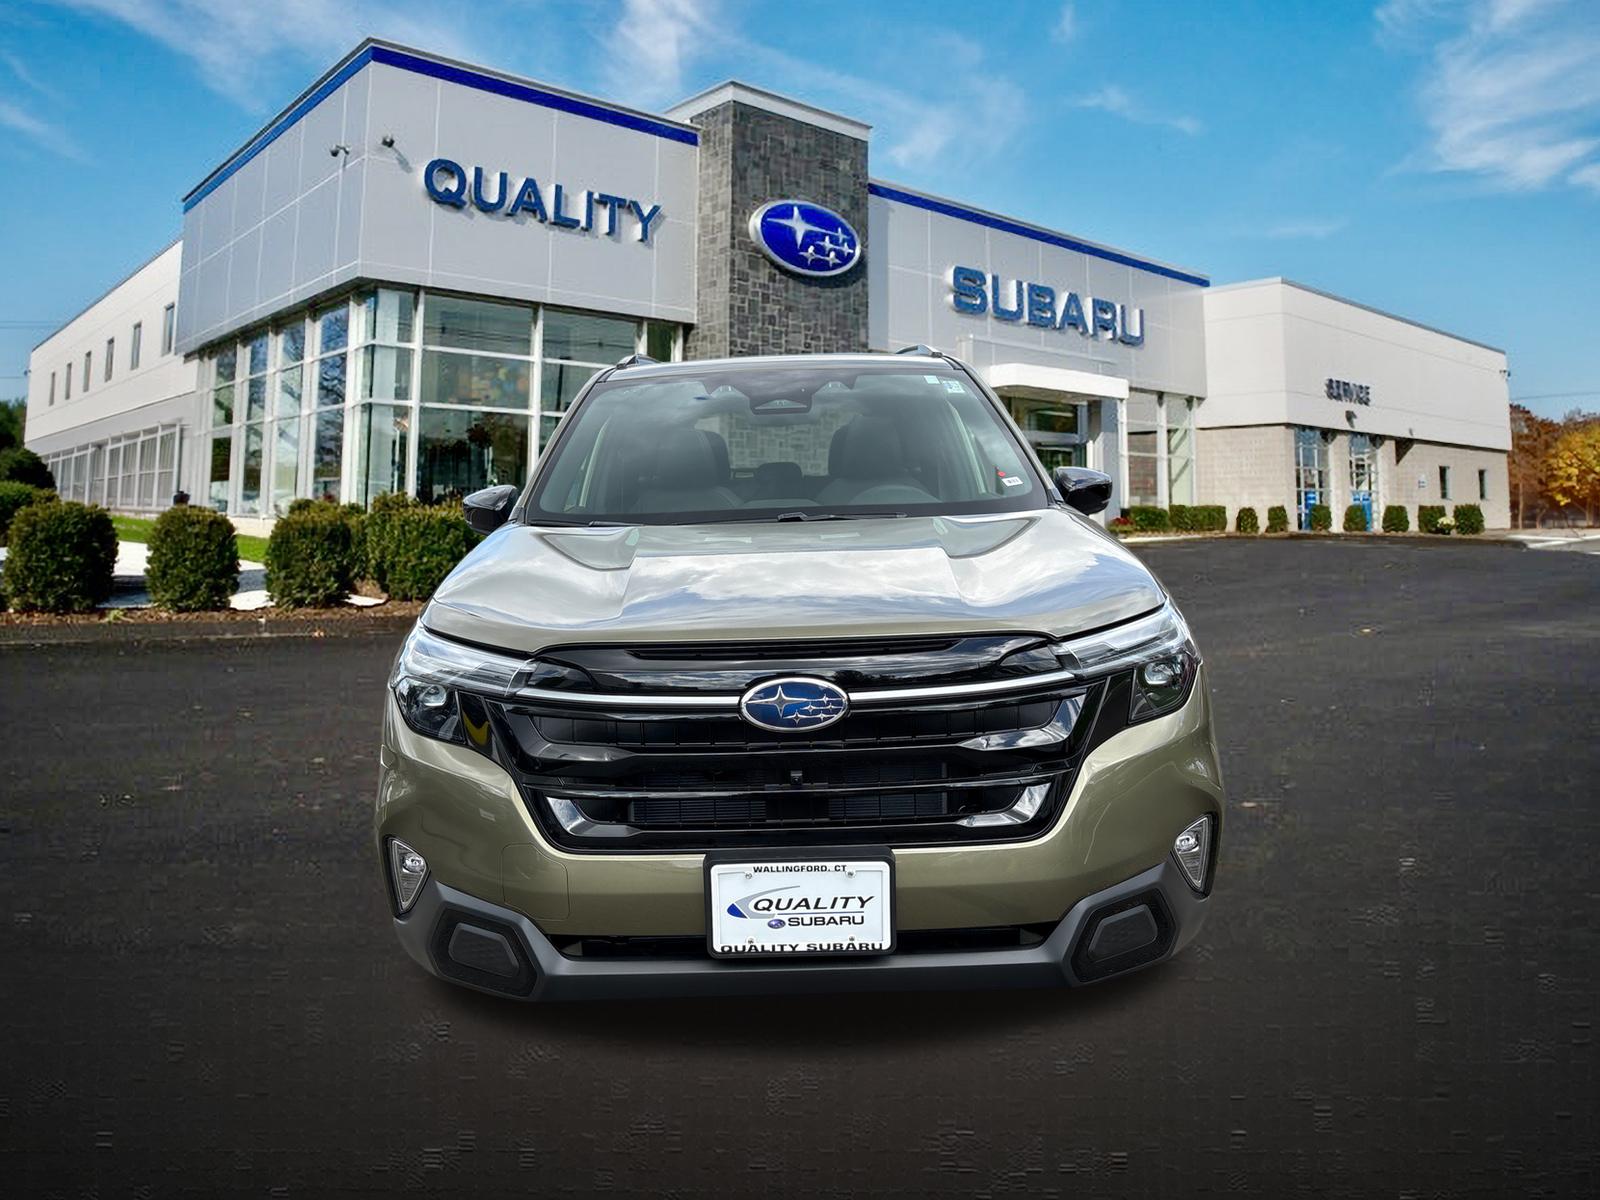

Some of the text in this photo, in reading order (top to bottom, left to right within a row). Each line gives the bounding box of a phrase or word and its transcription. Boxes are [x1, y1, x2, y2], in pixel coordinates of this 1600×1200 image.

[424, 158, 661, 242] QUALITY
[950, 265, 1144, 347] SUBARU
[834, 864, 847, 872] CT
[753, 896, 874, 911] QUALITY
[788, 916, 865, 927] SUBARU
[720, 942, 883, 953] QUALITY SUBARU
